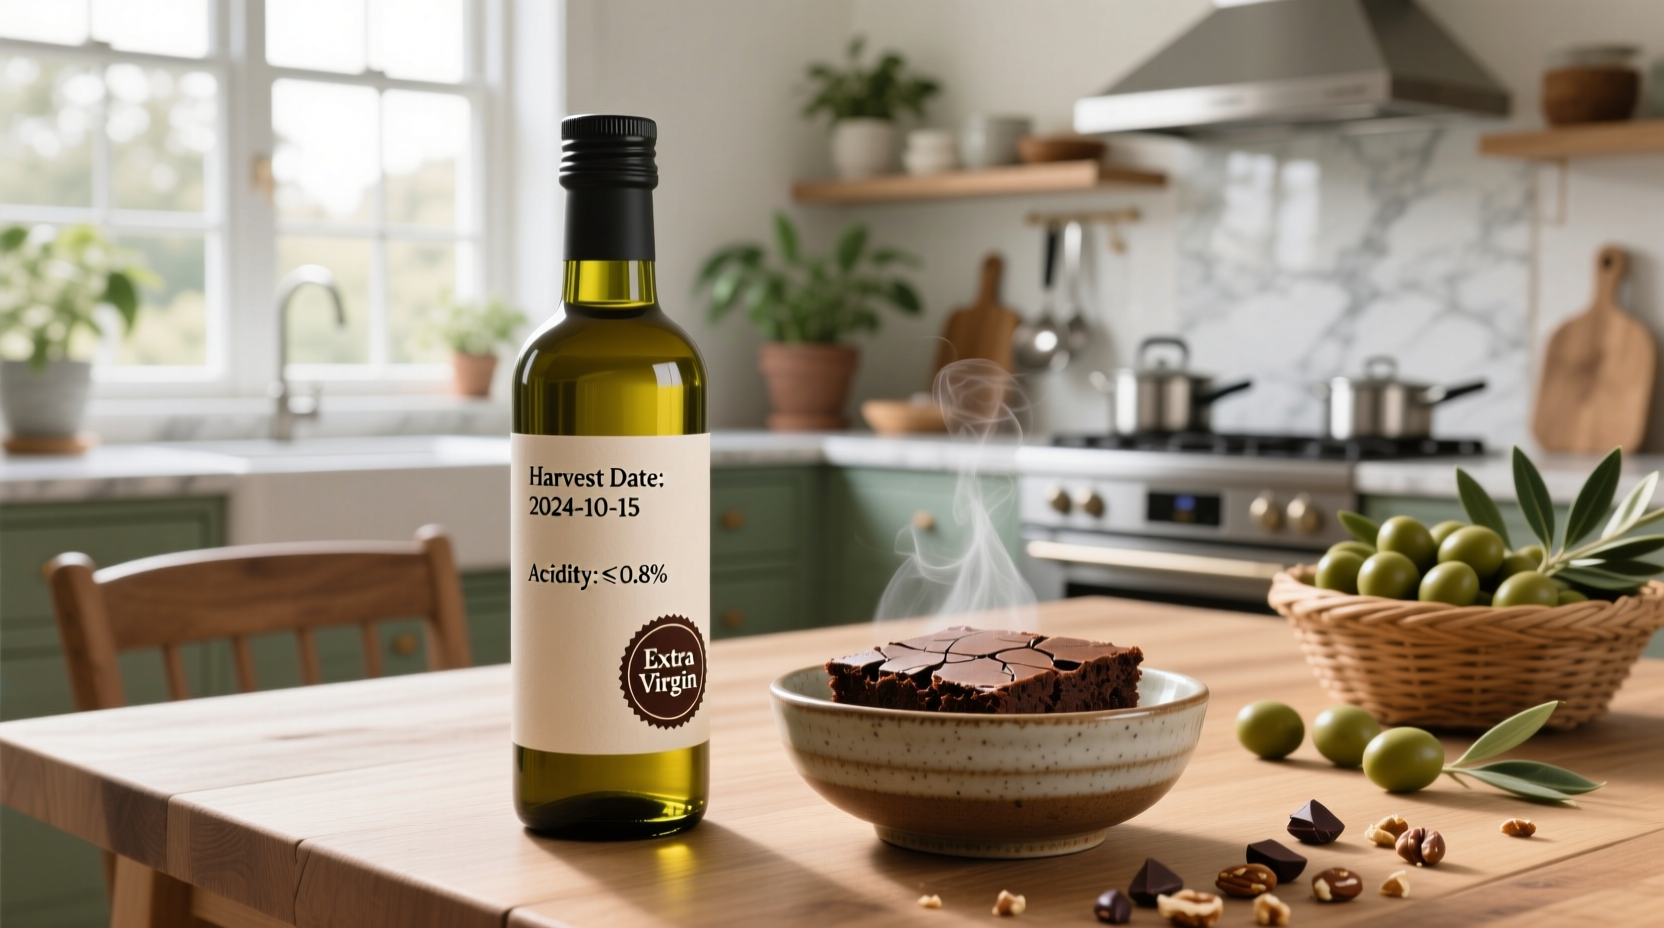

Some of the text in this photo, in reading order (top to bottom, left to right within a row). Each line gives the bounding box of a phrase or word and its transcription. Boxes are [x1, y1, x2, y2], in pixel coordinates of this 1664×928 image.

[529, 466, 665, 488] Harvest Date:
[529, 496, 641, 518] 2024-10-15
[643, 648, 695, 670] Extra
[639, 670, 698, 698] Virgin
